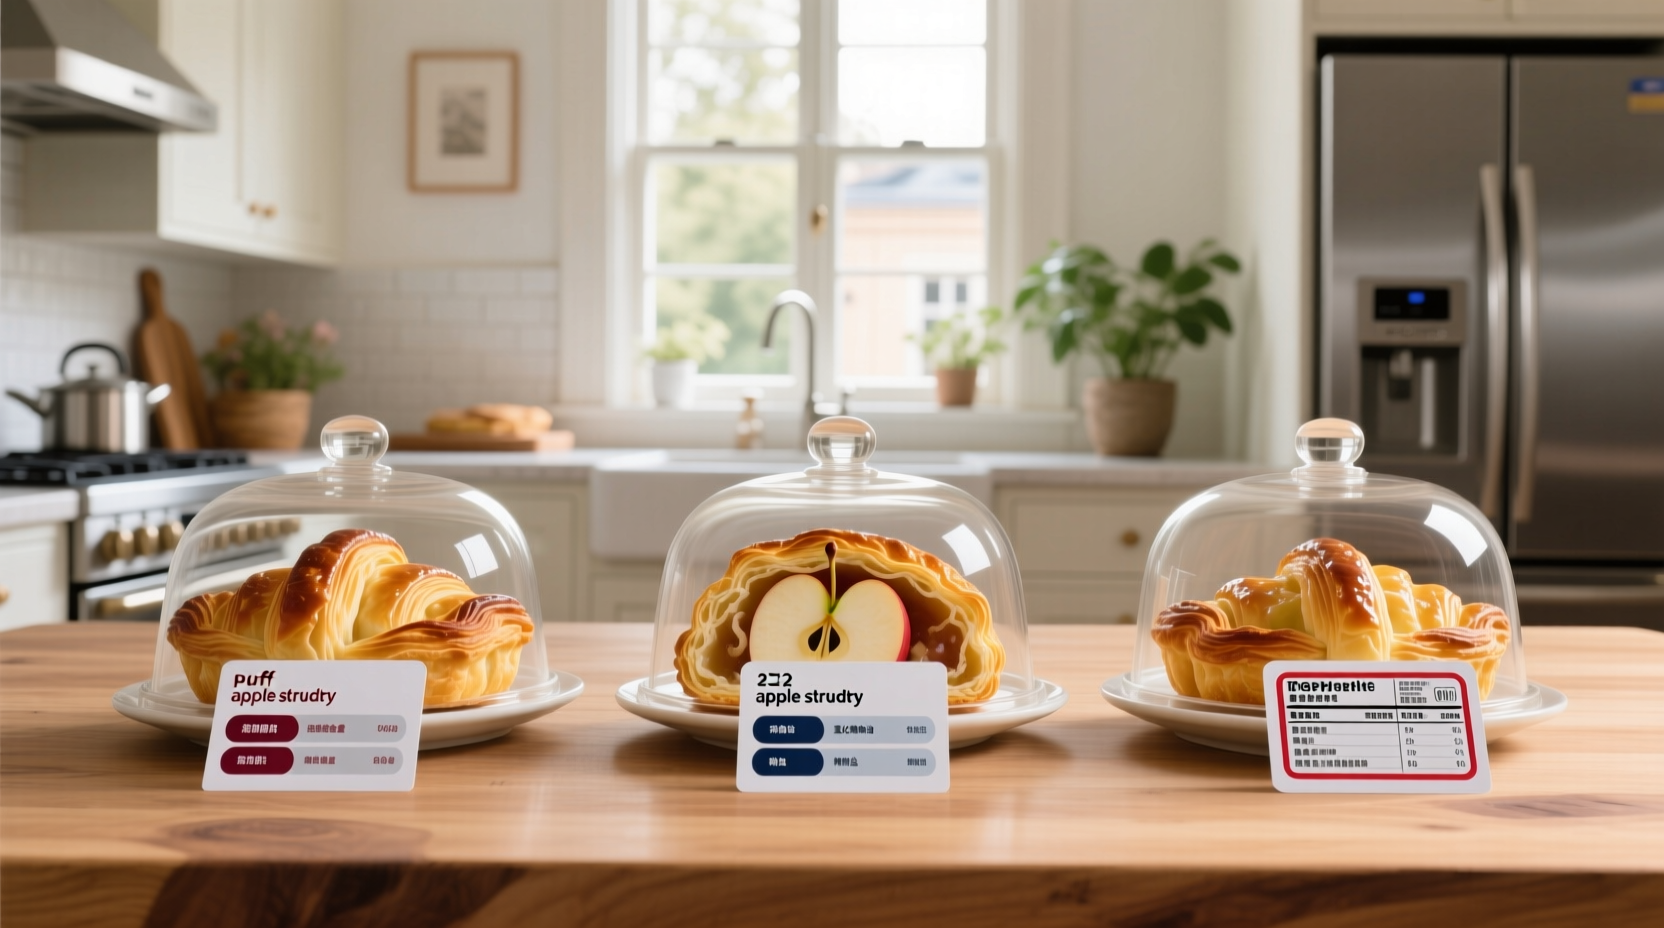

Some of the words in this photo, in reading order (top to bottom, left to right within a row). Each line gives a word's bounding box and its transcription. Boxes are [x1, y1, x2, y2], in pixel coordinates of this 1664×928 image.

[233, 670, 276, 688] puff
[231, 688, 276, 706] apple
[755, 688, 801, 707] apple
